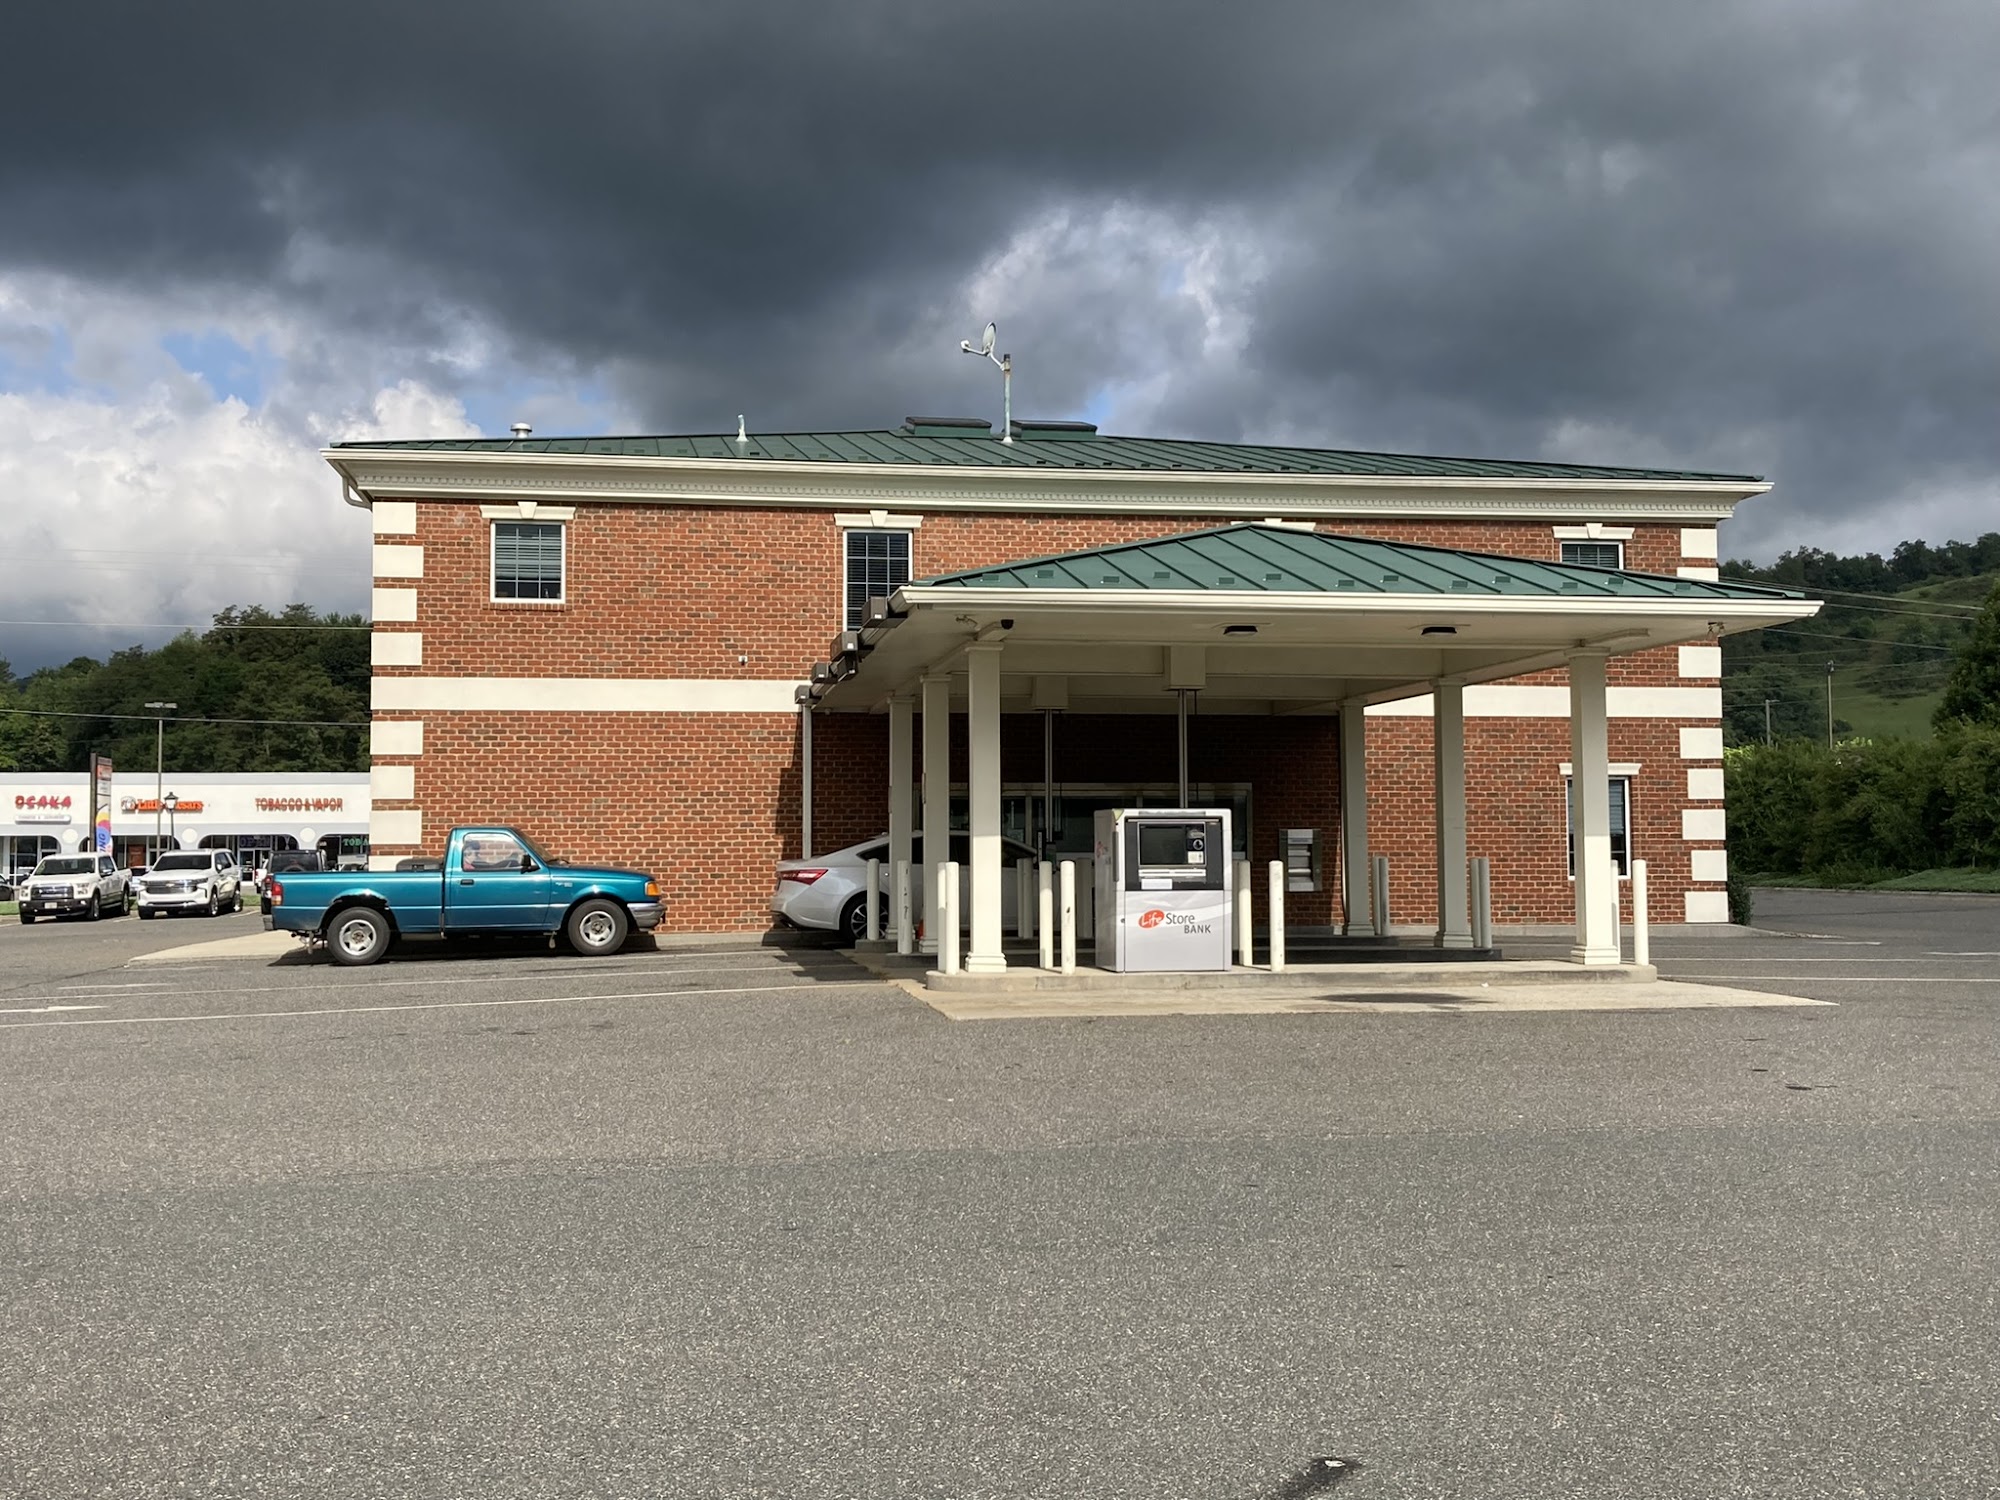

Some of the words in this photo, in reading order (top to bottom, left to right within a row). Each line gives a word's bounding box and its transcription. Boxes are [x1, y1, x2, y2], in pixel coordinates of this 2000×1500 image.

[15, 795, 72, 810] OSAKA
[255, 797, 302, 812] TOBACCO
[304, 798, 311, 811] &
[311, 797, 344, 812] VAPOR
[1140, 912, 1163, 927] Life
[1166, 912, 1195, 925] Store
[1184, 924, 1211, 934] BANK
